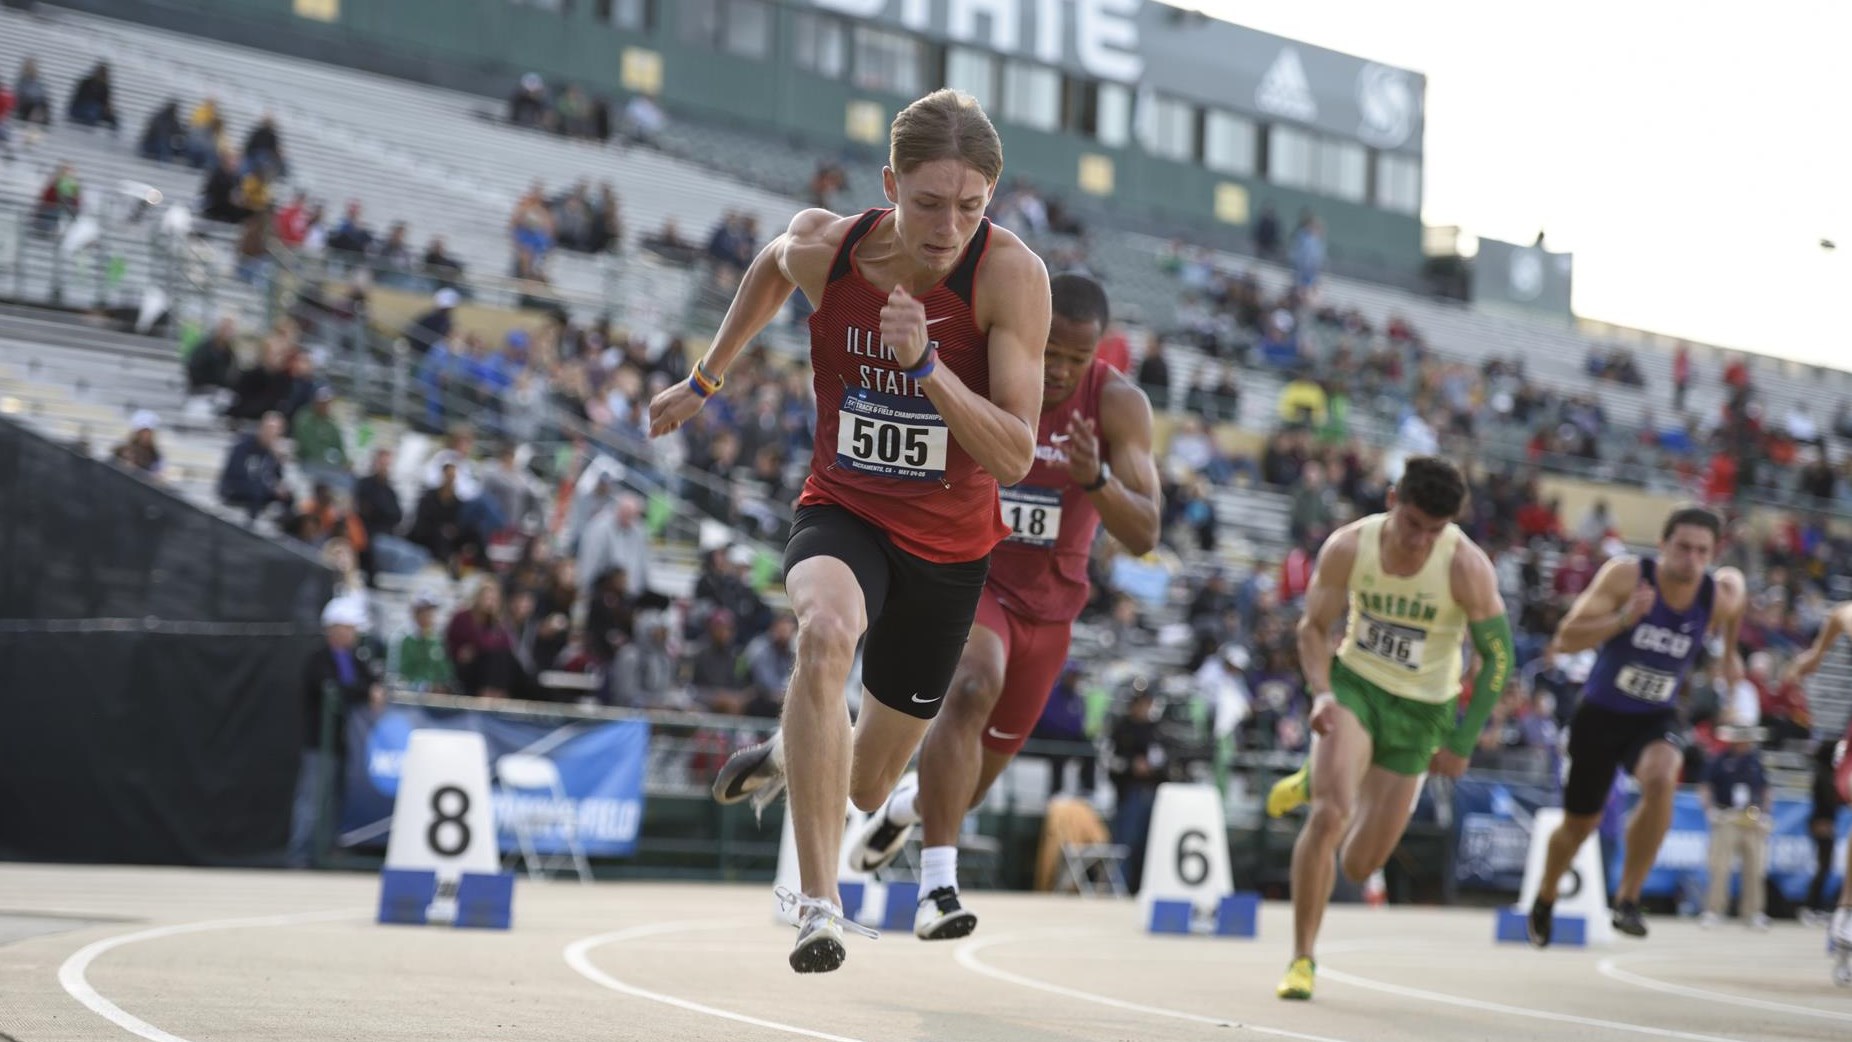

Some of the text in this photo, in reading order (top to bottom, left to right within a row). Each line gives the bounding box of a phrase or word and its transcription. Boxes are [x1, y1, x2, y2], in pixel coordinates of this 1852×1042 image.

[860, 364, 924, 398] STATE
[855, 402, 873, 412] TRACK
[878, 406, 893, 417] FIELD
[852, 417, 929, 467] 505
[1010, 506, 1047, 536] 18
[427, 785, 471, 857] 8
[1176, 829, 1210, 886] 6
